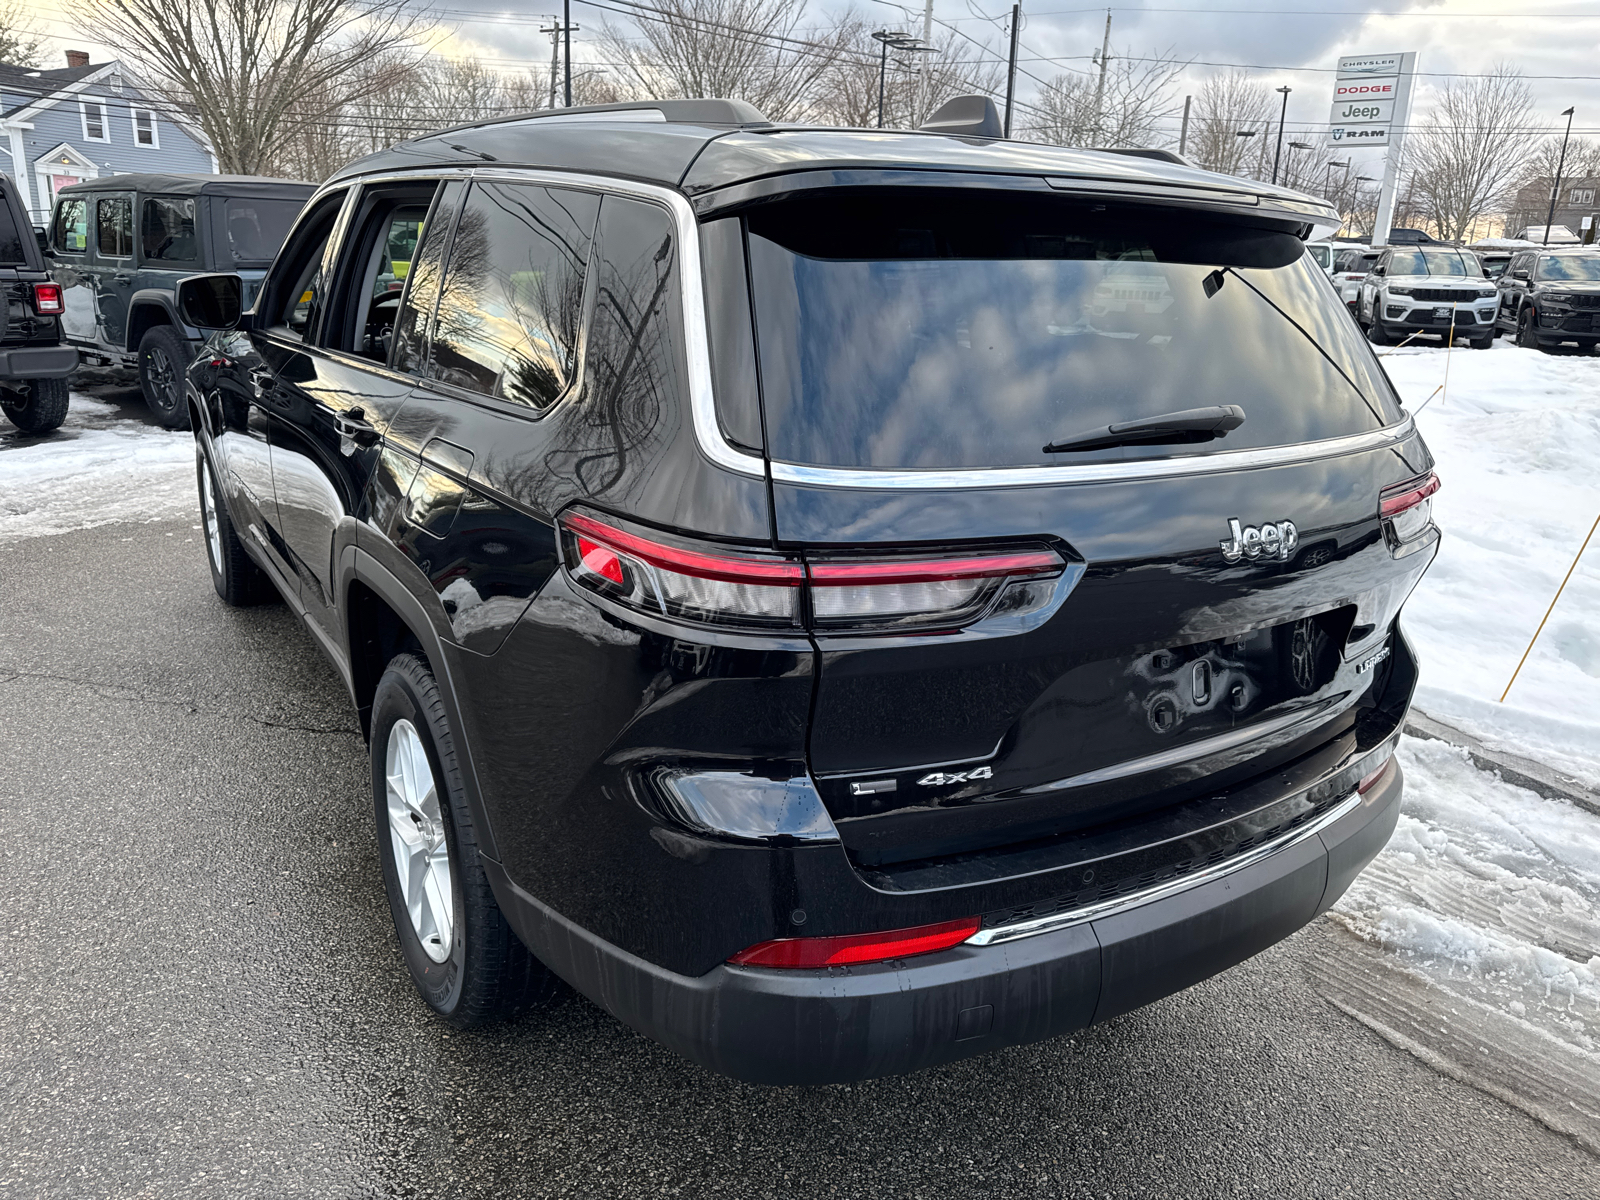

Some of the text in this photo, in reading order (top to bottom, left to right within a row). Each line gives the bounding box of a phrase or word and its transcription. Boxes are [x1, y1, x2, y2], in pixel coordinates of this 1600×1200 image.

[1337, 85, 1392, 94] DODGE
[1342, 105, 1380, 119] Jeep
[1219, 517, 1298, 563] Jeep
[916, 766, 993, 786] 4x4
